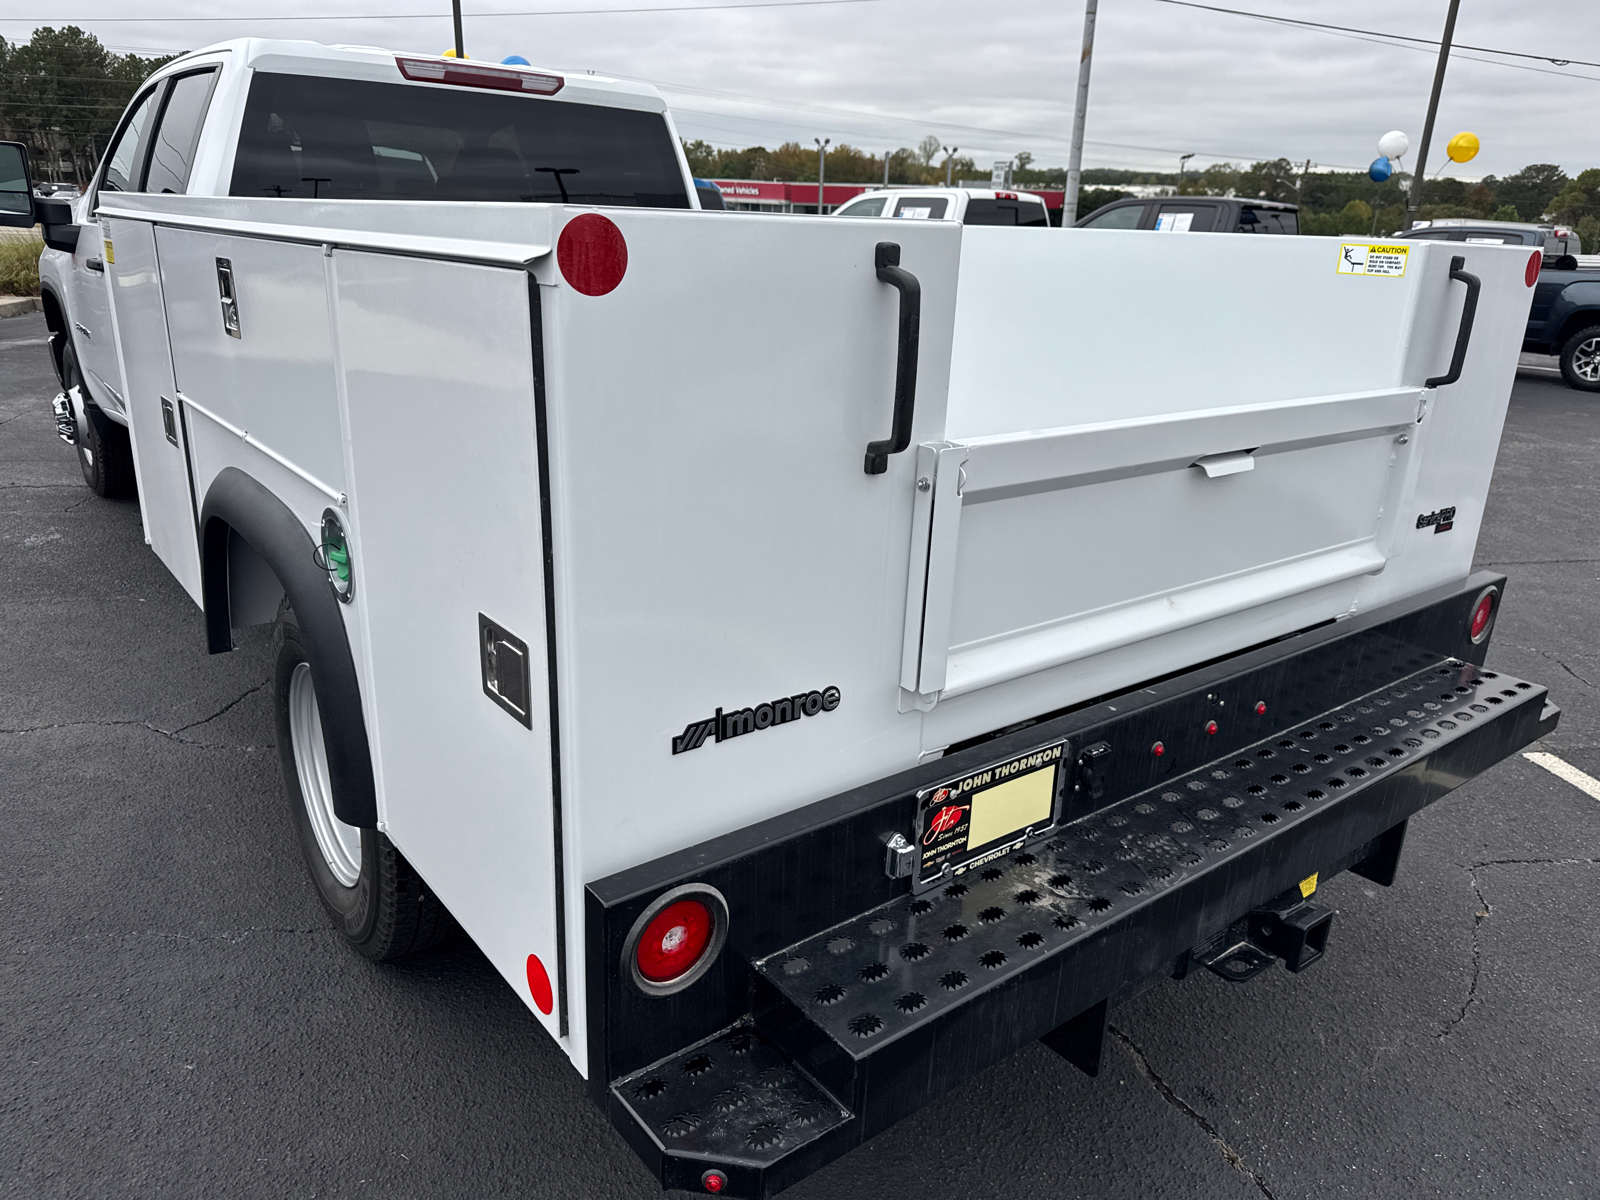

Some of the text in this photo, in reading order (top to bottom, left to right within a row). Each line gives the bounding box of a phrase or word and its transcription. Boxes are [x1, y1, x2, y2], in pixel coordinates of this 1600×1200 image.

[736, 185, 759, 195] Vehicles
[722, 685, 841, 740] monroe
[956, 746, 1062, 794] JOHN THORNTON
[937, 823, 969, 842] Since 1957
[922, 848, 936, 860] JOHN
[936, 836, 967, 853] THORNTON
[969, 846, 1011, 869] CHEVROLET
